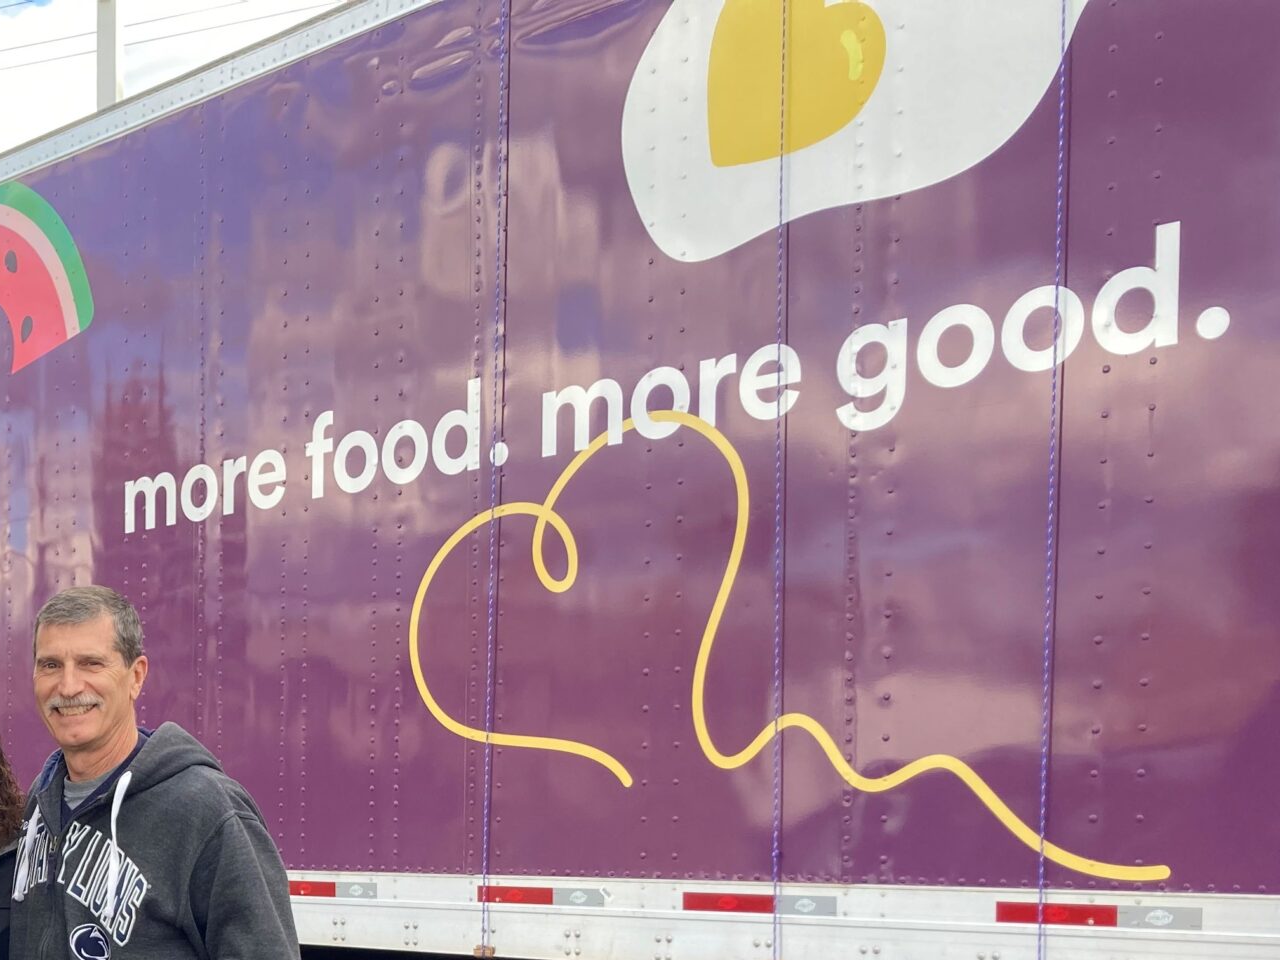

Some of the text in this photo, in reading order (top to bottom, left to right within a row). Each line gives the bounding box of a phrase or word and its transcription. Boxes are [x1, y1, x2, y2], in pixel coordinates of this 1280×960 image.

[124, 220, 1231, 533] more food. more good.
